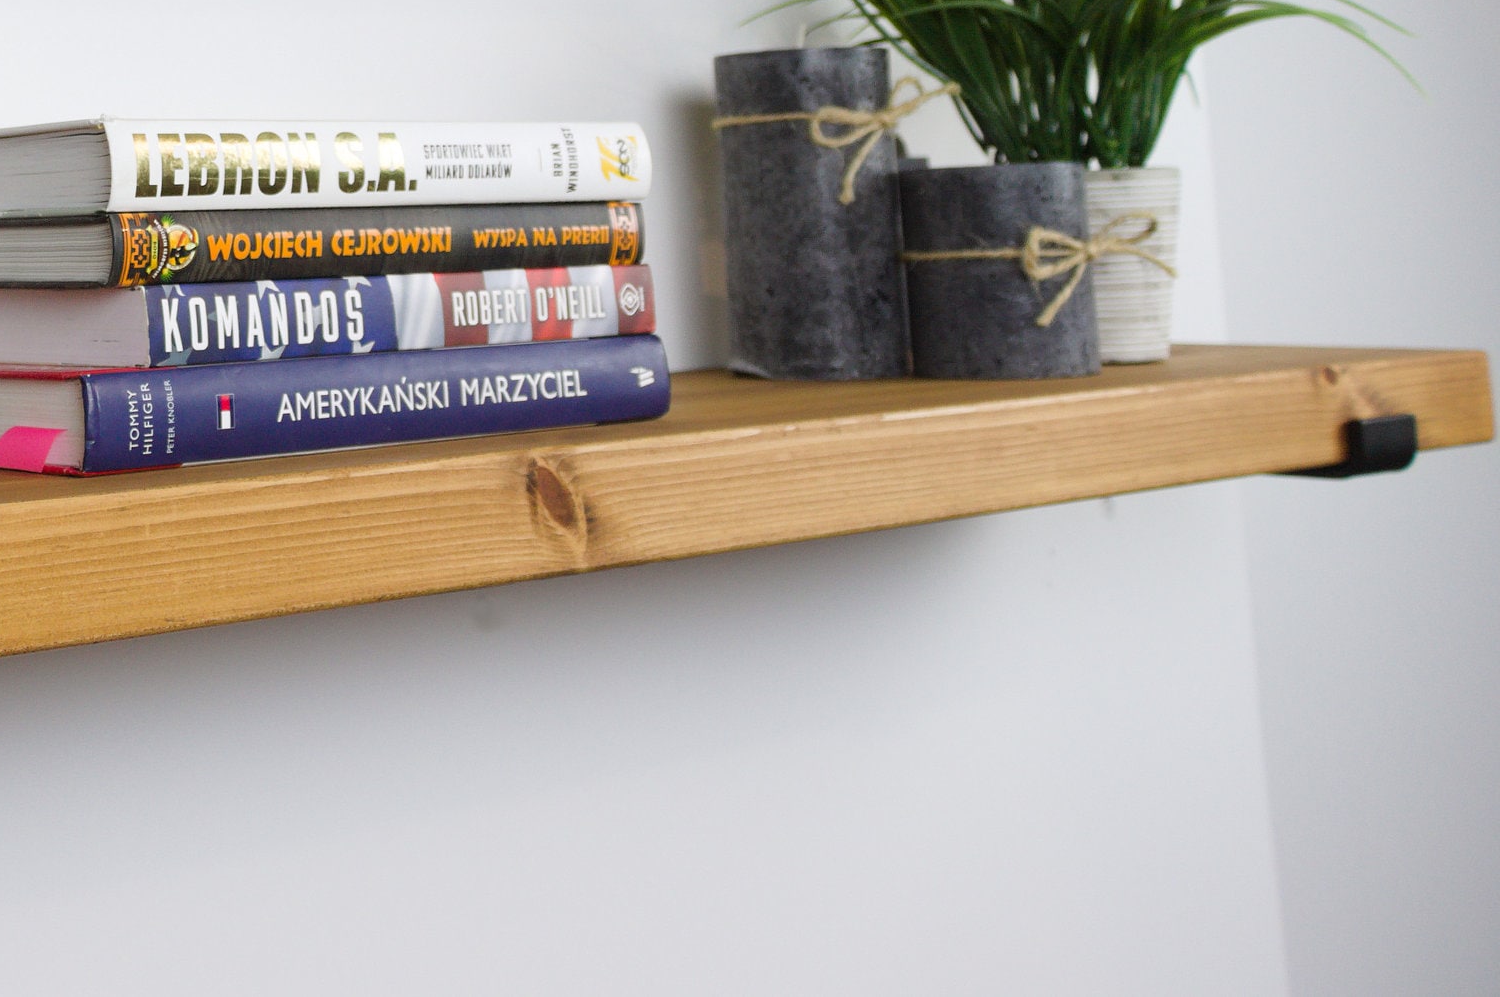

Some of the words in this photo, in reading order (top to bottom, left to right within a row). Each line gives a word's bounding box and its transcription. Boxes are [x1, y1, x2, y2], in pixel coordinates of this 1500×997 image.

[132, 131, 321, 198] LEBRON
[334, 131, 418, 193] S.A.
[422, 143, 485, 160] SPORTOWIEC
[486, 143, 513, 159] WART
[425, 163, 465, 180] MILIARD
[468, 161, 513, 180] DOLARÓW
[550, 143, 563, 177] BRIAN
[561, 128, 579, 194] WINDHORST
[206, 230, 323, 262] WOJCIECH
[331, 226, 452, 257] CEJROWSKI
[472, 227, 529, 249] WYSPA
[532, 226, 558, 246] NA
[561, 225, 610, 246] PRERII
[161, 289, 365, 353] KOMANDOS
[451, 288, 528, 327] ROBERT
[535, 285, 607, 322] O'NEILL
[163, 379, 176, 424] KNOBLER
[276, 376, 450, 423] AMERYKAŃSKI
[459, 369, 588, 407] MARZYCIEL
[126, 390, 140, 451] TOMMY
[140, 382, 154, 455] HILFIGER
[165, 426, 176, 454] PETER
